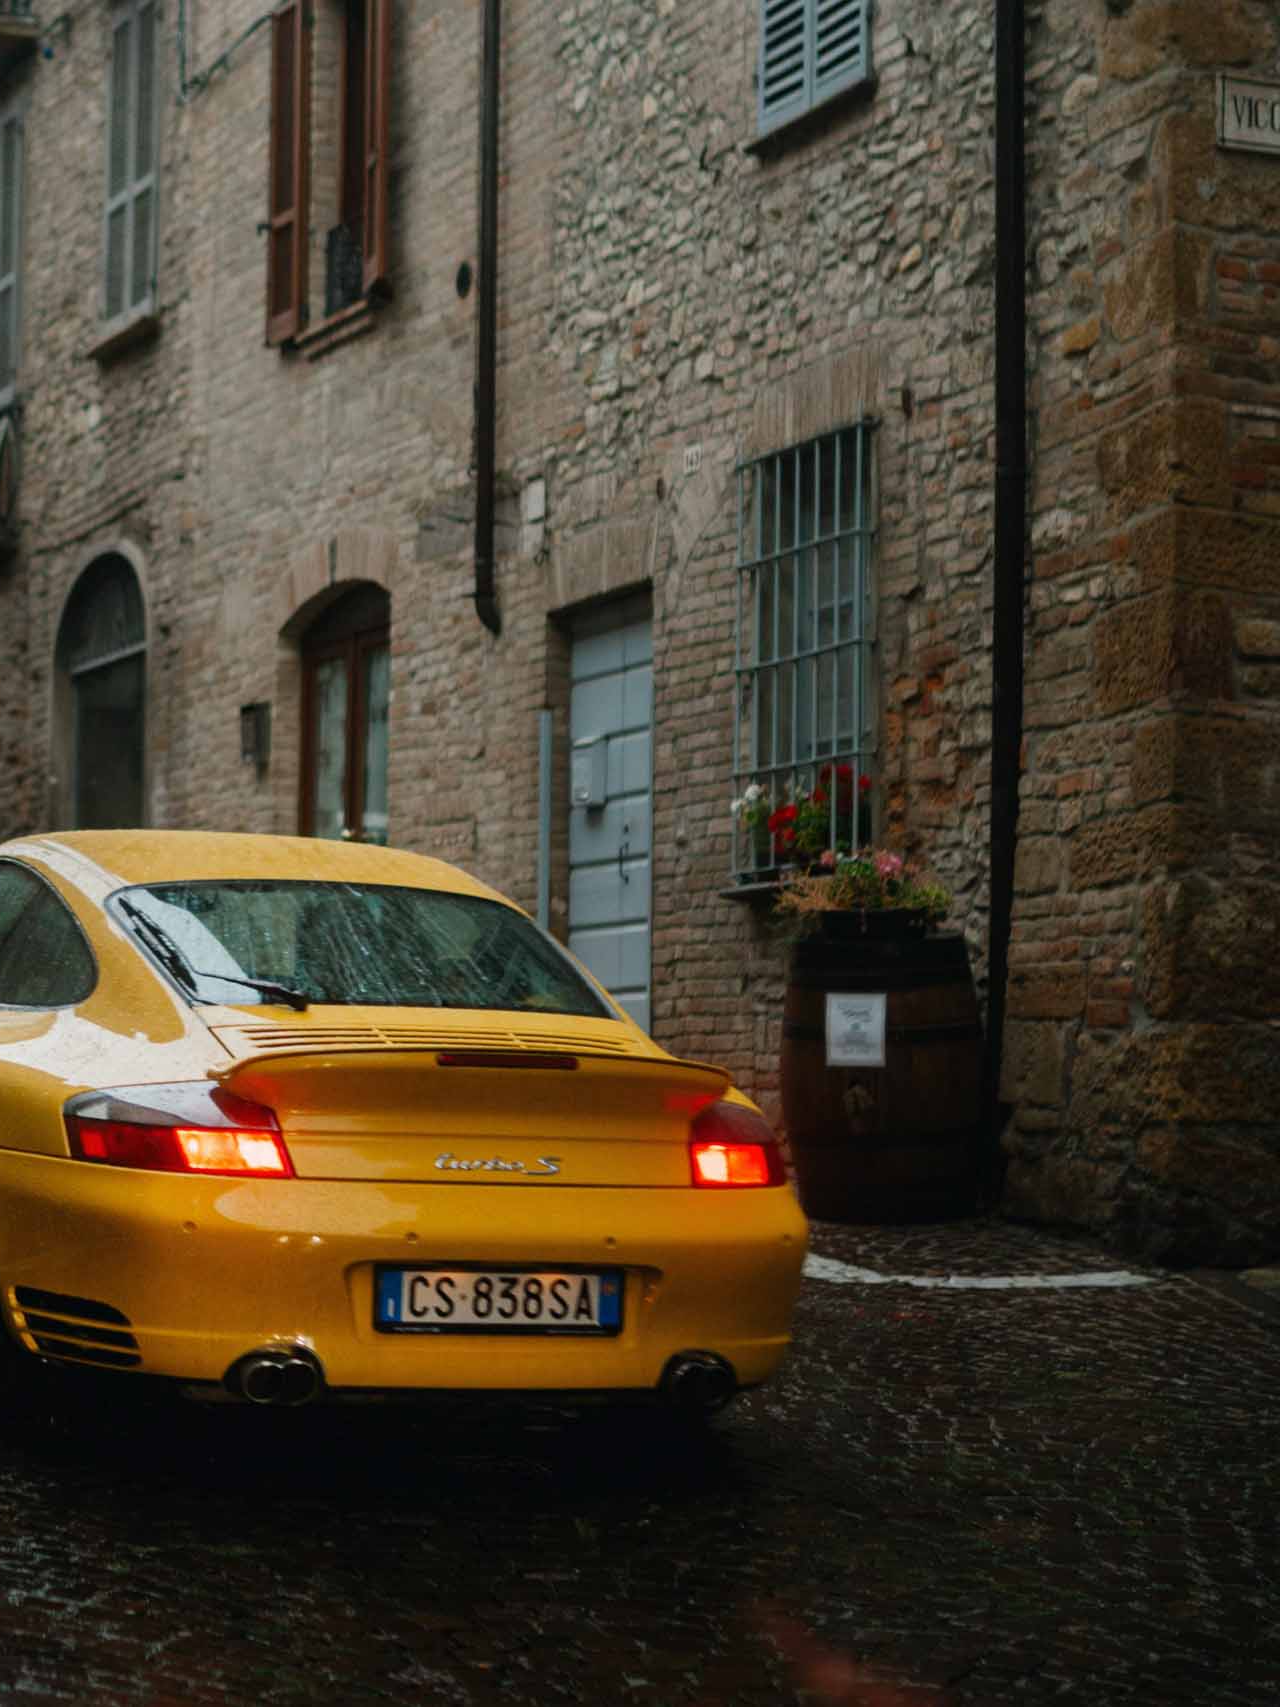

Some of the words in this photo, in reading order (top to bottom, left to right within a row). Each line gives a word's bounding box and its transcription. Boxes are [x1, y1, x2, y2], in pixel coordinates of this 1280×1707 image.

[522, 1156, 561, 1175] S
[410, 1275, 456, 1318] CS
[472, 1276, 593, 1320] 838SA
